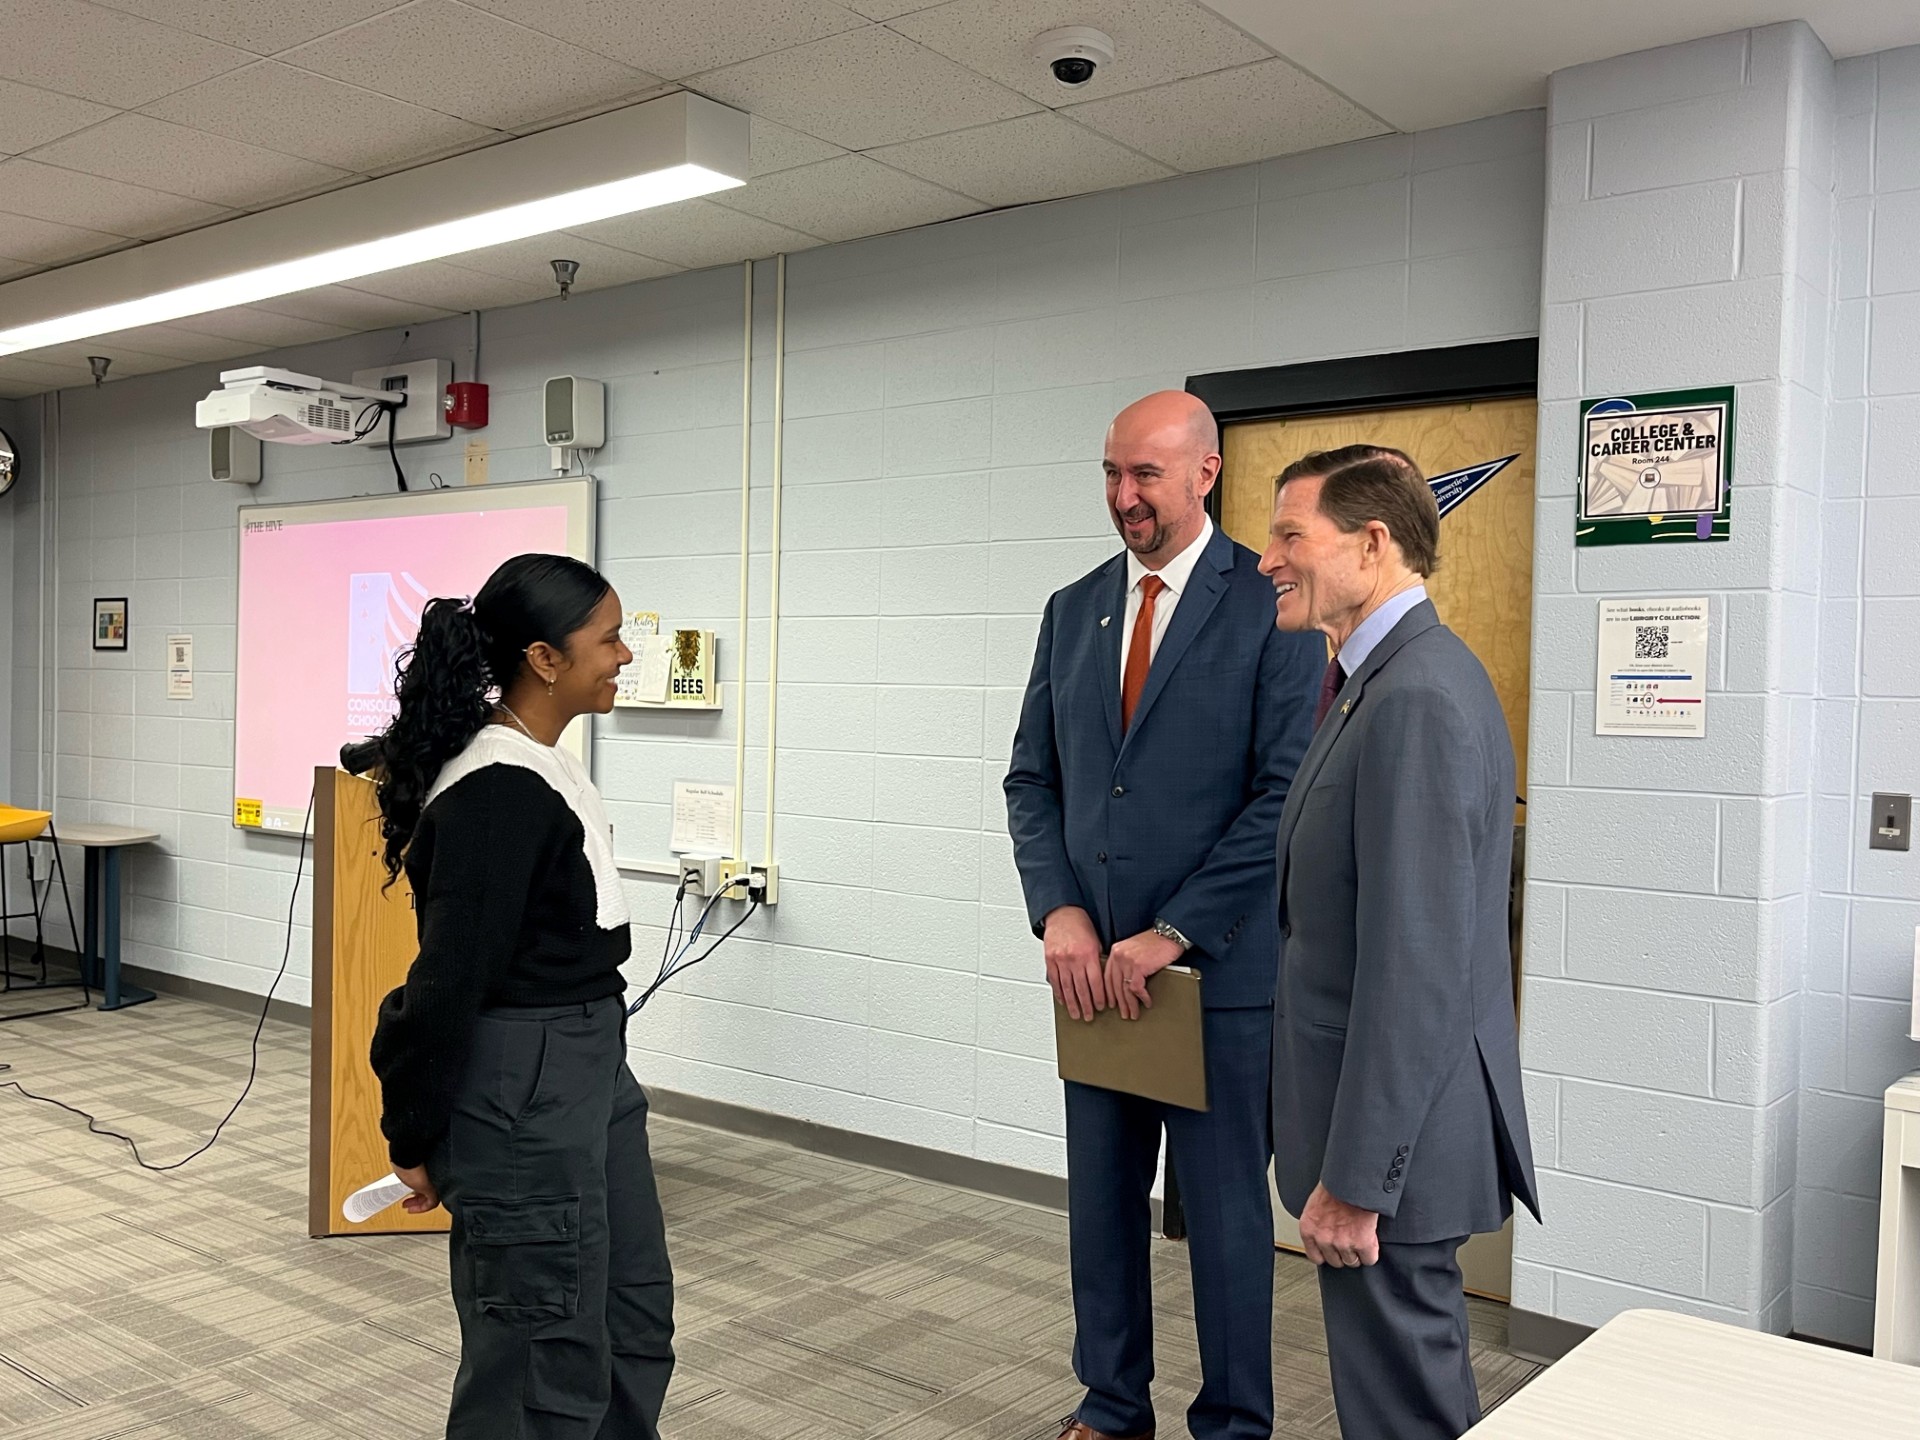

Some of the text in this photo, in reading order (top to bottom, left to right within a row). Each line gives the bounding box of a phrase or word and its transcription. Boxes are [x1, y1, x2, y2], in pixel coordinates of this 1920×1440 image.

[1611, 422, 1694, 441] COLLEGE &
[1591, 434, 1716, 456] CAREER CENTER
[1632, 455, 1670, 465] Room 244
[1432, 475, 1469, 496] Connecticut
[1436, 486, 1462, 503] niversity
[250, 520, 283, 533] THE HIVE
[673, 678, 703, 694] BEES
